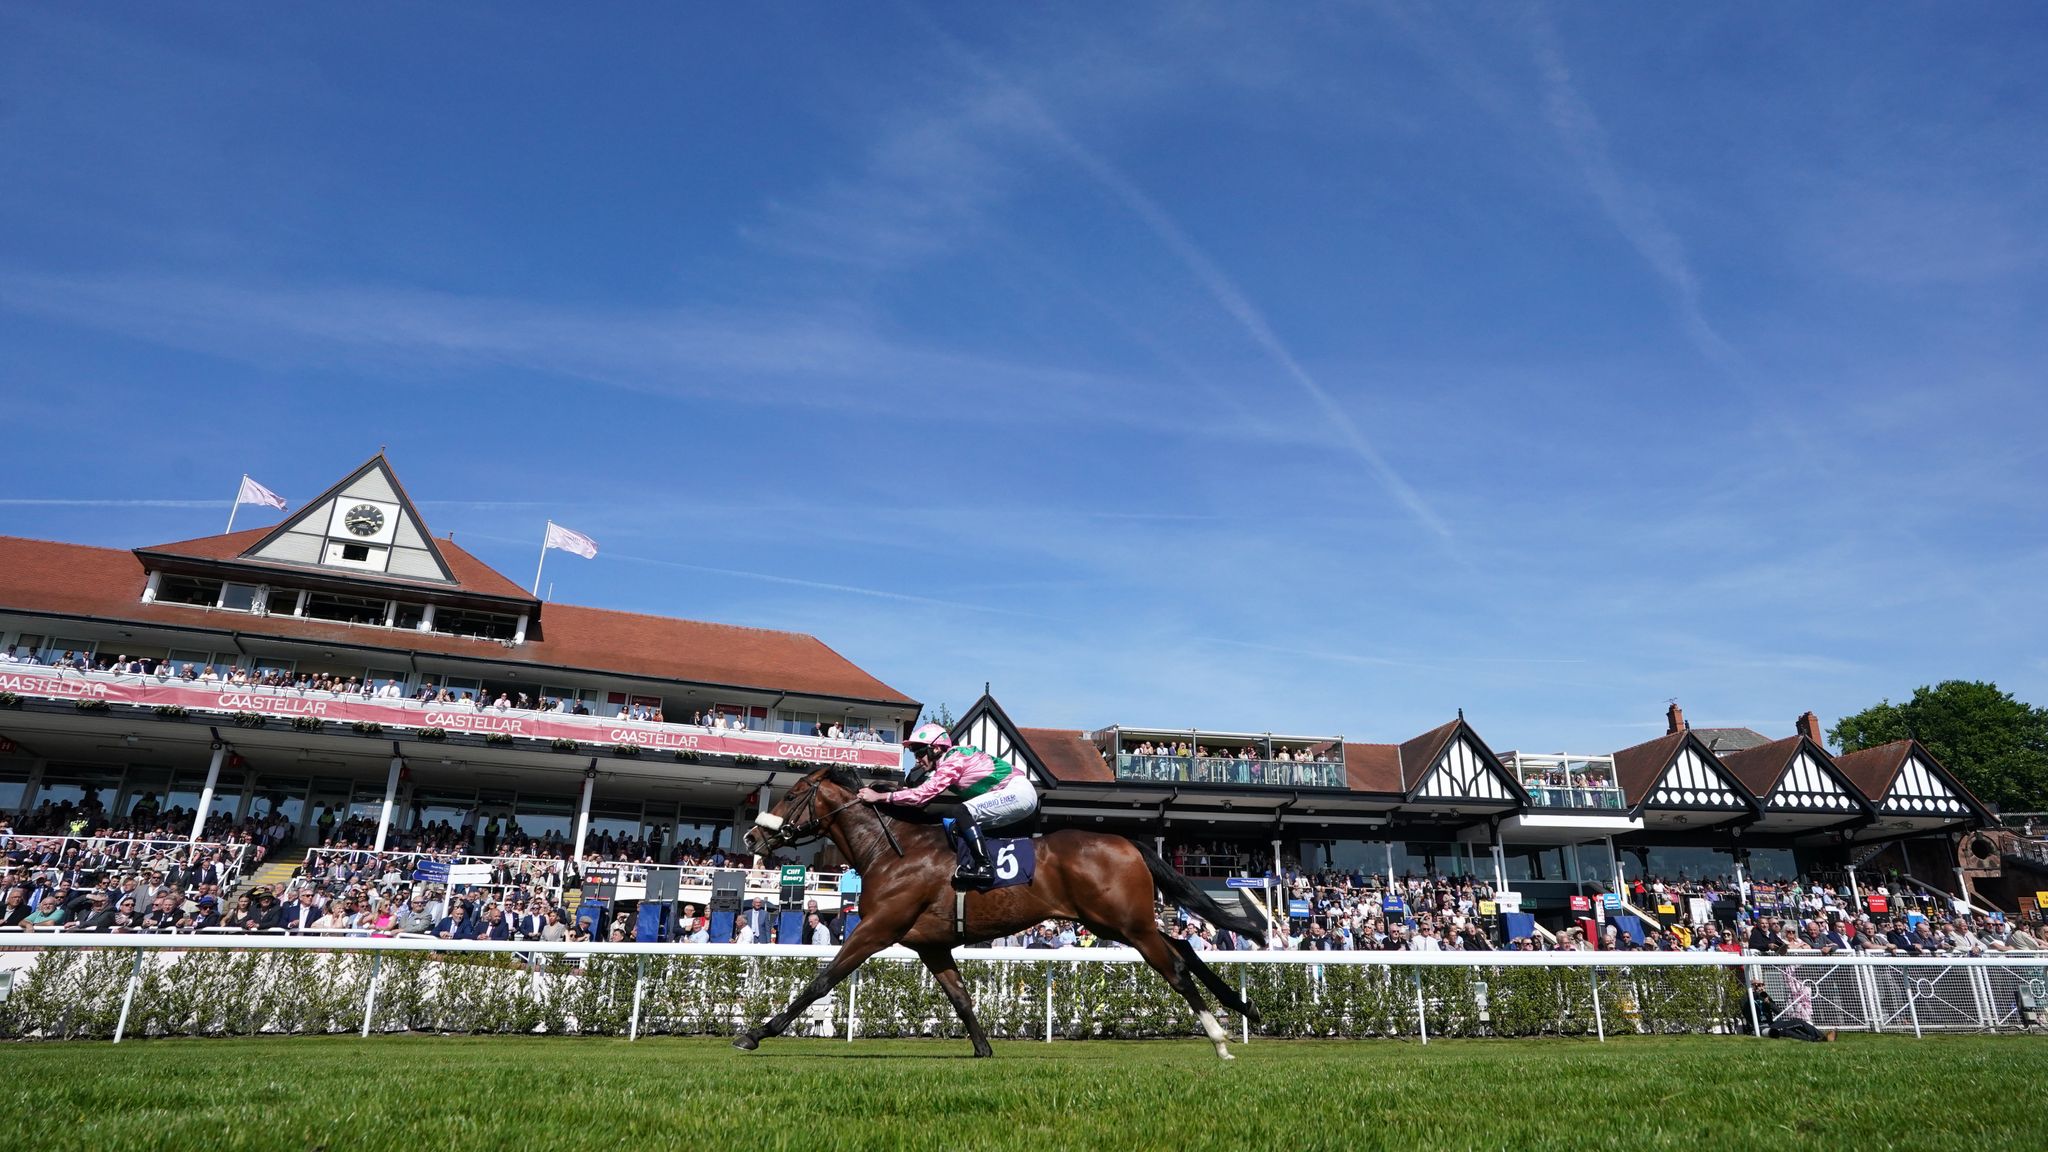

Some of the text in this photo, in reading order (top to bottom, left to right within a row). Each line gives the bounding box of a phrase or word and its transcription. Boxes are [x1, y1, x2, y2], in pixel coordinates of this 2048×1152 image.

[0, 675, 107, 697] AASTELLAR
[218, 694, 327, 714] CAASTELLAR
[425, 713, 522, 732] CAASTELLAR
[610, 729, 698, 747] CAASTELLAR
[778, 744, 859, 761] CAASTELLAR
[976, 798, 1000, 810] PROBIO
[996, 843, 1019, 880] 5
